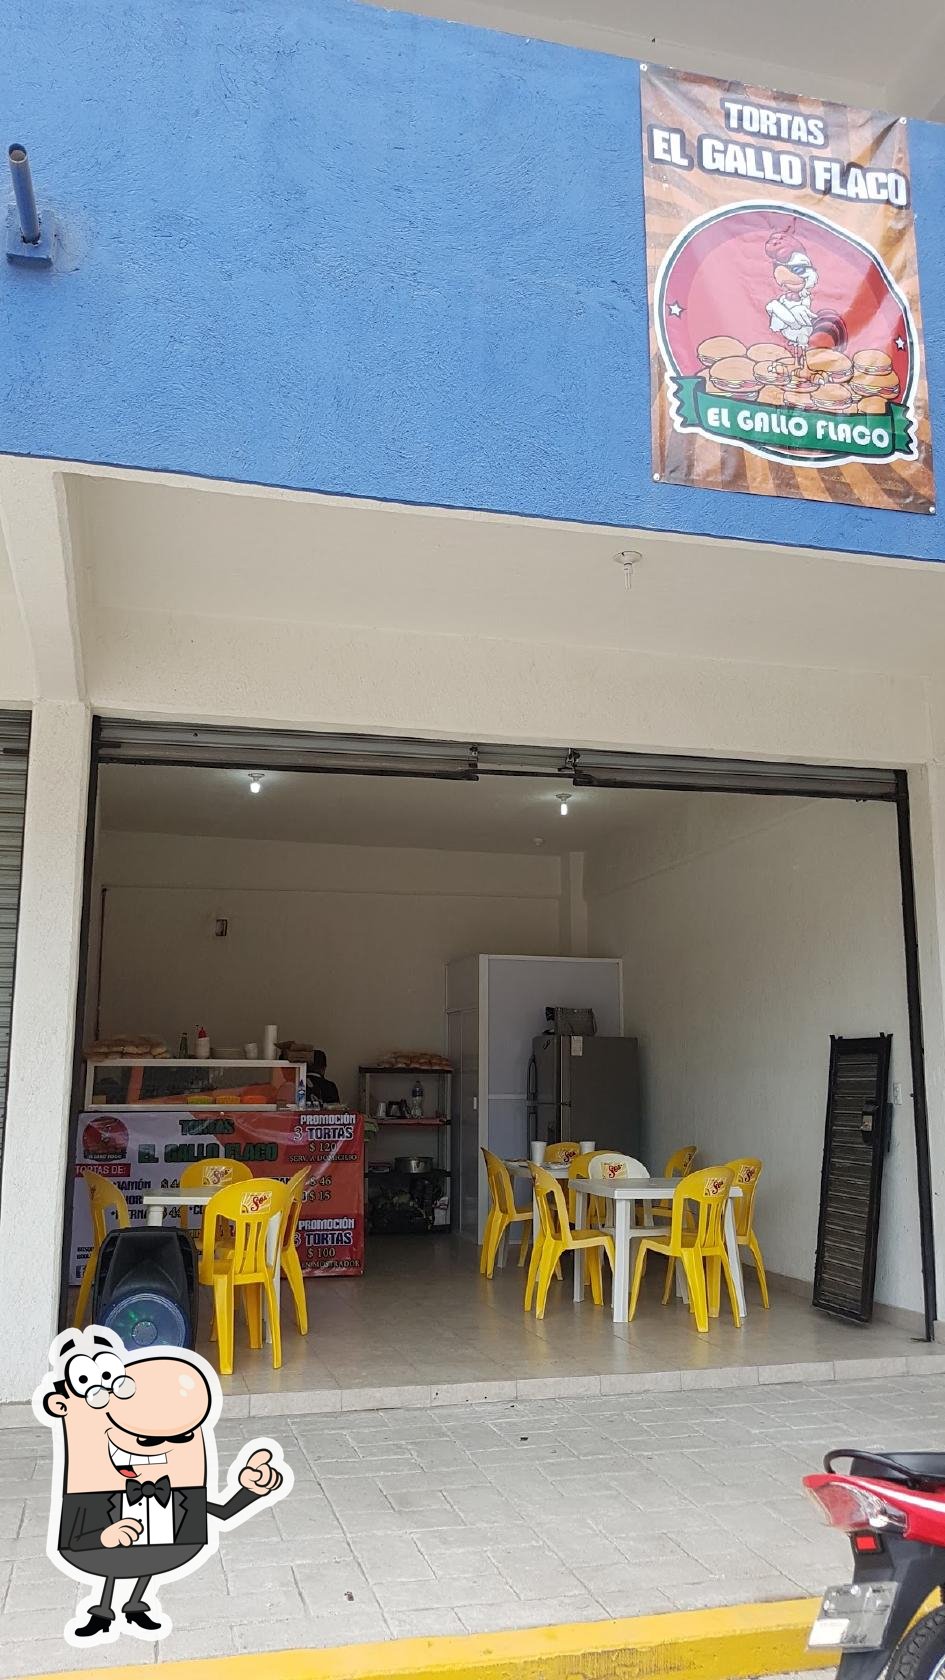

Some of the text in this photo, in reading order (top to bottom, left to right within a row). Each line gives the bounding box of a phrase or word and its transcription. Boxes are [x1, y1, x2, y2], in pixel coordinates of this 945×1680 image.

[723, 101, 825, 145] TORTAS
[652, 128, 908, 206] EL GALLO FLACO
[706, 405, 891, 449] EL GALLO FLACO
[300, 1113, 356, 1126] PROMOCIÓN
[293, 1125, 354, 1141] 3 TORTAS
[320, 1143, 337, 1152] 120
[111, 1165, 126, 1174] DE:
[298, 1217, 355, 1230] PROMOCIÓN
[305, 1230, 353, 1246] TORTAS
[318, 1247, 336, 1257] 100
